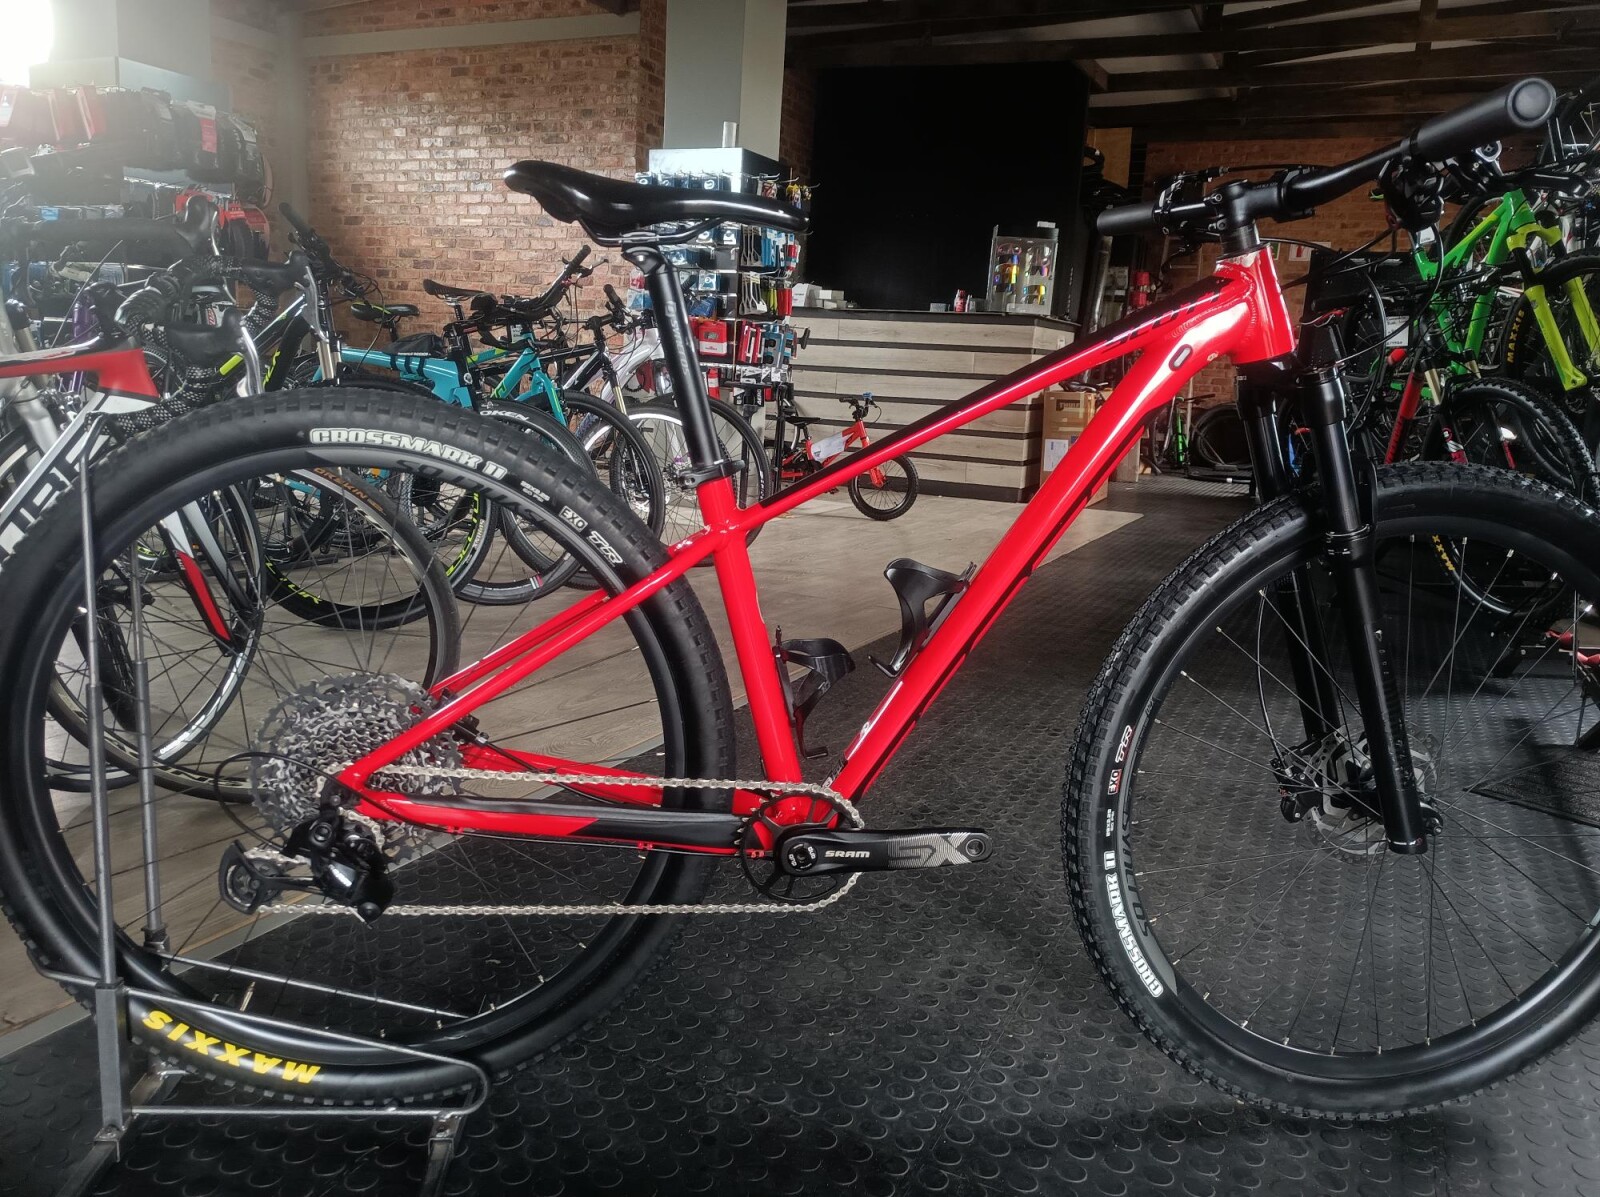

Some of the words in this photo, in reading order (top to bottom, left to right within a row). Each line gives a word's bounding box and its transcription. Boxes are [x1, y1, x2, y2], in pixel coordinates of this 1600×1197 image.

[1506, 309, 1525, 364] MAXXIS
[479, 409, 530, 421] OKEN
[309, 427, 483, 471] CROSSMARK
[482, 458, 508, 480] II
[559, 506, 587, 531] EXO
[1431, 534, 1455, 572] MAXX
[1108, 768, 1121, 795] EXO
[824, 850, 870, 858] SRAM
[1104, 850, 1116, 871] II
[1105, 872, 1164, 998] CROSSMARK
[142, 1010, 321, 1084] MAXXIS
